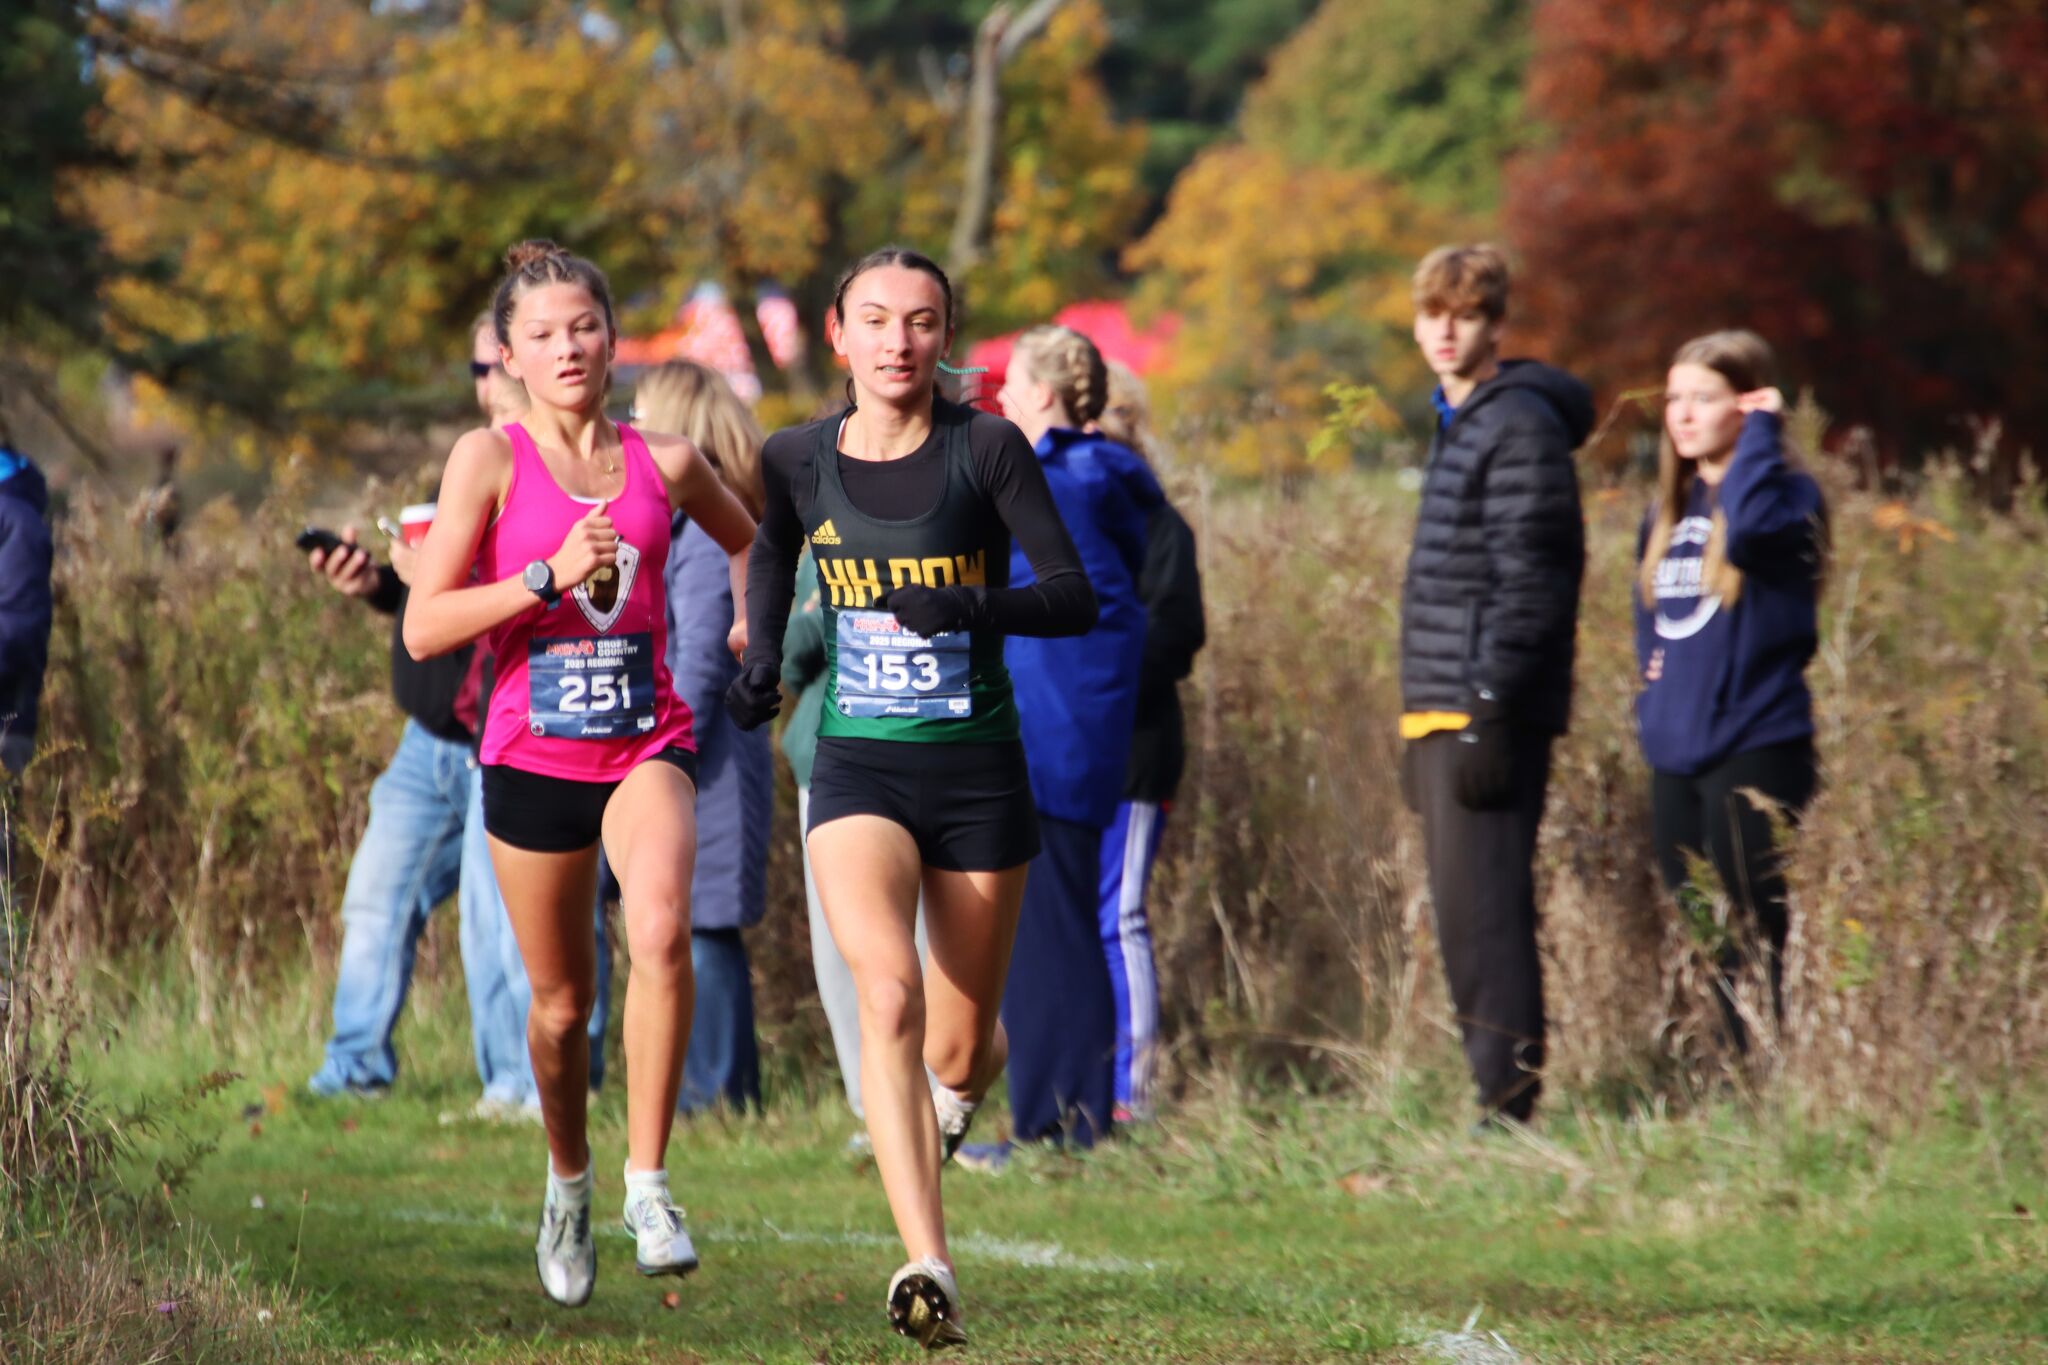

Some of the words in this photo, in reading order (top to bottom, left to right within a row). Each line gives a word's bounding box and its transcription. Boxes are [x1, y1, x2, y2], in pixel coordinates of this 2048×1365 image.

[812, 535, 841, 545] adidas
[598, 646, 638, 657] COUNTRY
[587, 657, 624, 669] REGIONAL
[863, 652, 941, 692] 153
[558, 674, 632, 712] 251
